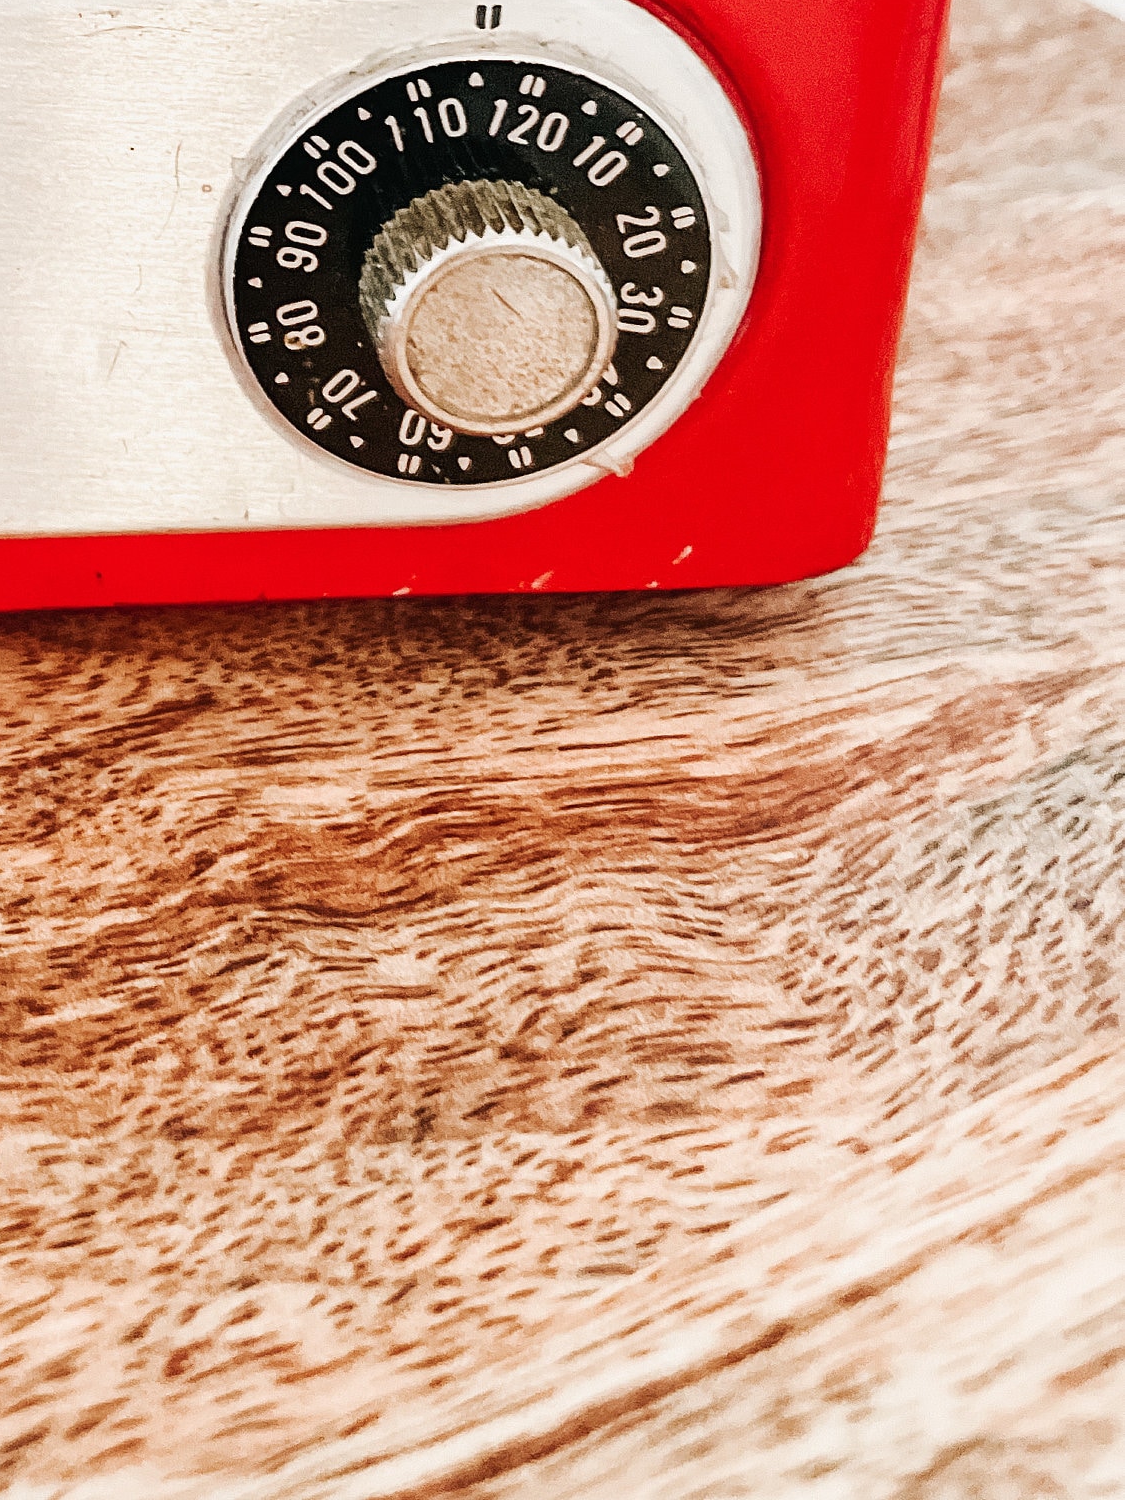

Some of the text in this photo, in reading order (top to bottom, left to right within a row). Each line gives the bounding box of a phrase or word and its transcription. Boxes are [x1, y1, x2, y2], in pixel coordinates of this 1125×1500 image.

[384, 97, 468, 152] 110
[488, 98, 570, 152] 120
[299, 140, 377, 211] 100
[572, 135, 629, 187] 10
[276, 220, 328, 273] 90
[616, 205, 667, 259] 20
[276, 299, 326, 351] 80
[616, 281, 664, 334] 30
[321, 368, 378, 422] 70
